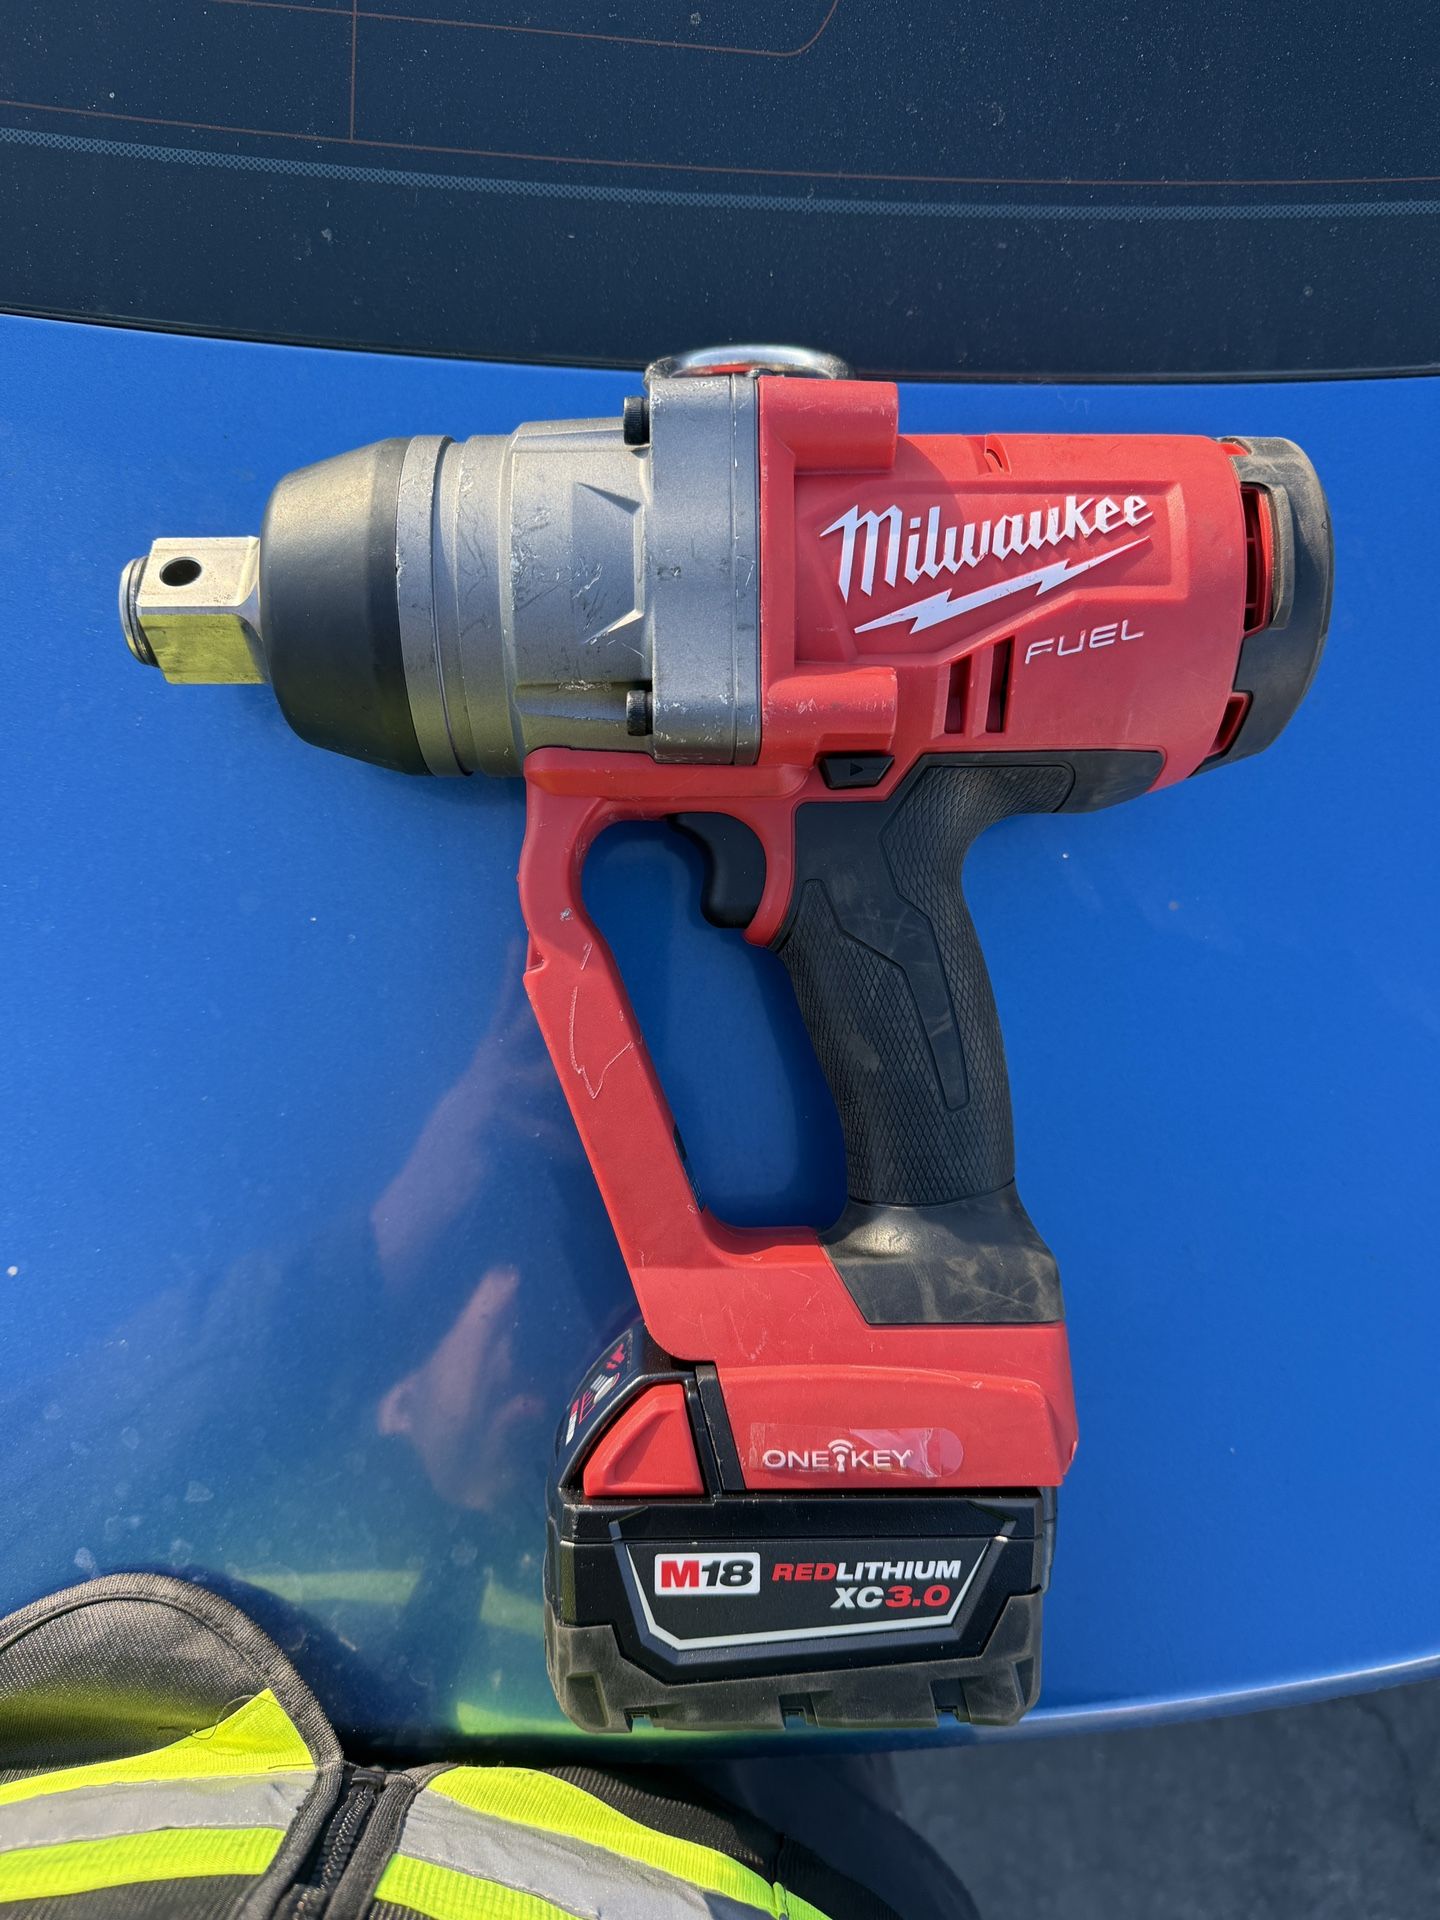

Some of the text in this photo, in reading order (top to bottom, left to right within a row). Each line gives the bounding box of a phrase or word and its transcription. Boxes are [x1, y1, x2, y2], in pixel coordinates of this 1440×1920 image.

[819, 494, 1153, 604] Milwaukee
[1024, 619, 1145, 665] FUEL
[762, 1449, 913, 1469] ONE KEY
[660, 1558, 756, 1590] M18
[771, 1559, 962, 1582] REDLITHIUM
[829, 1585, 951, 1610] XC3.0
